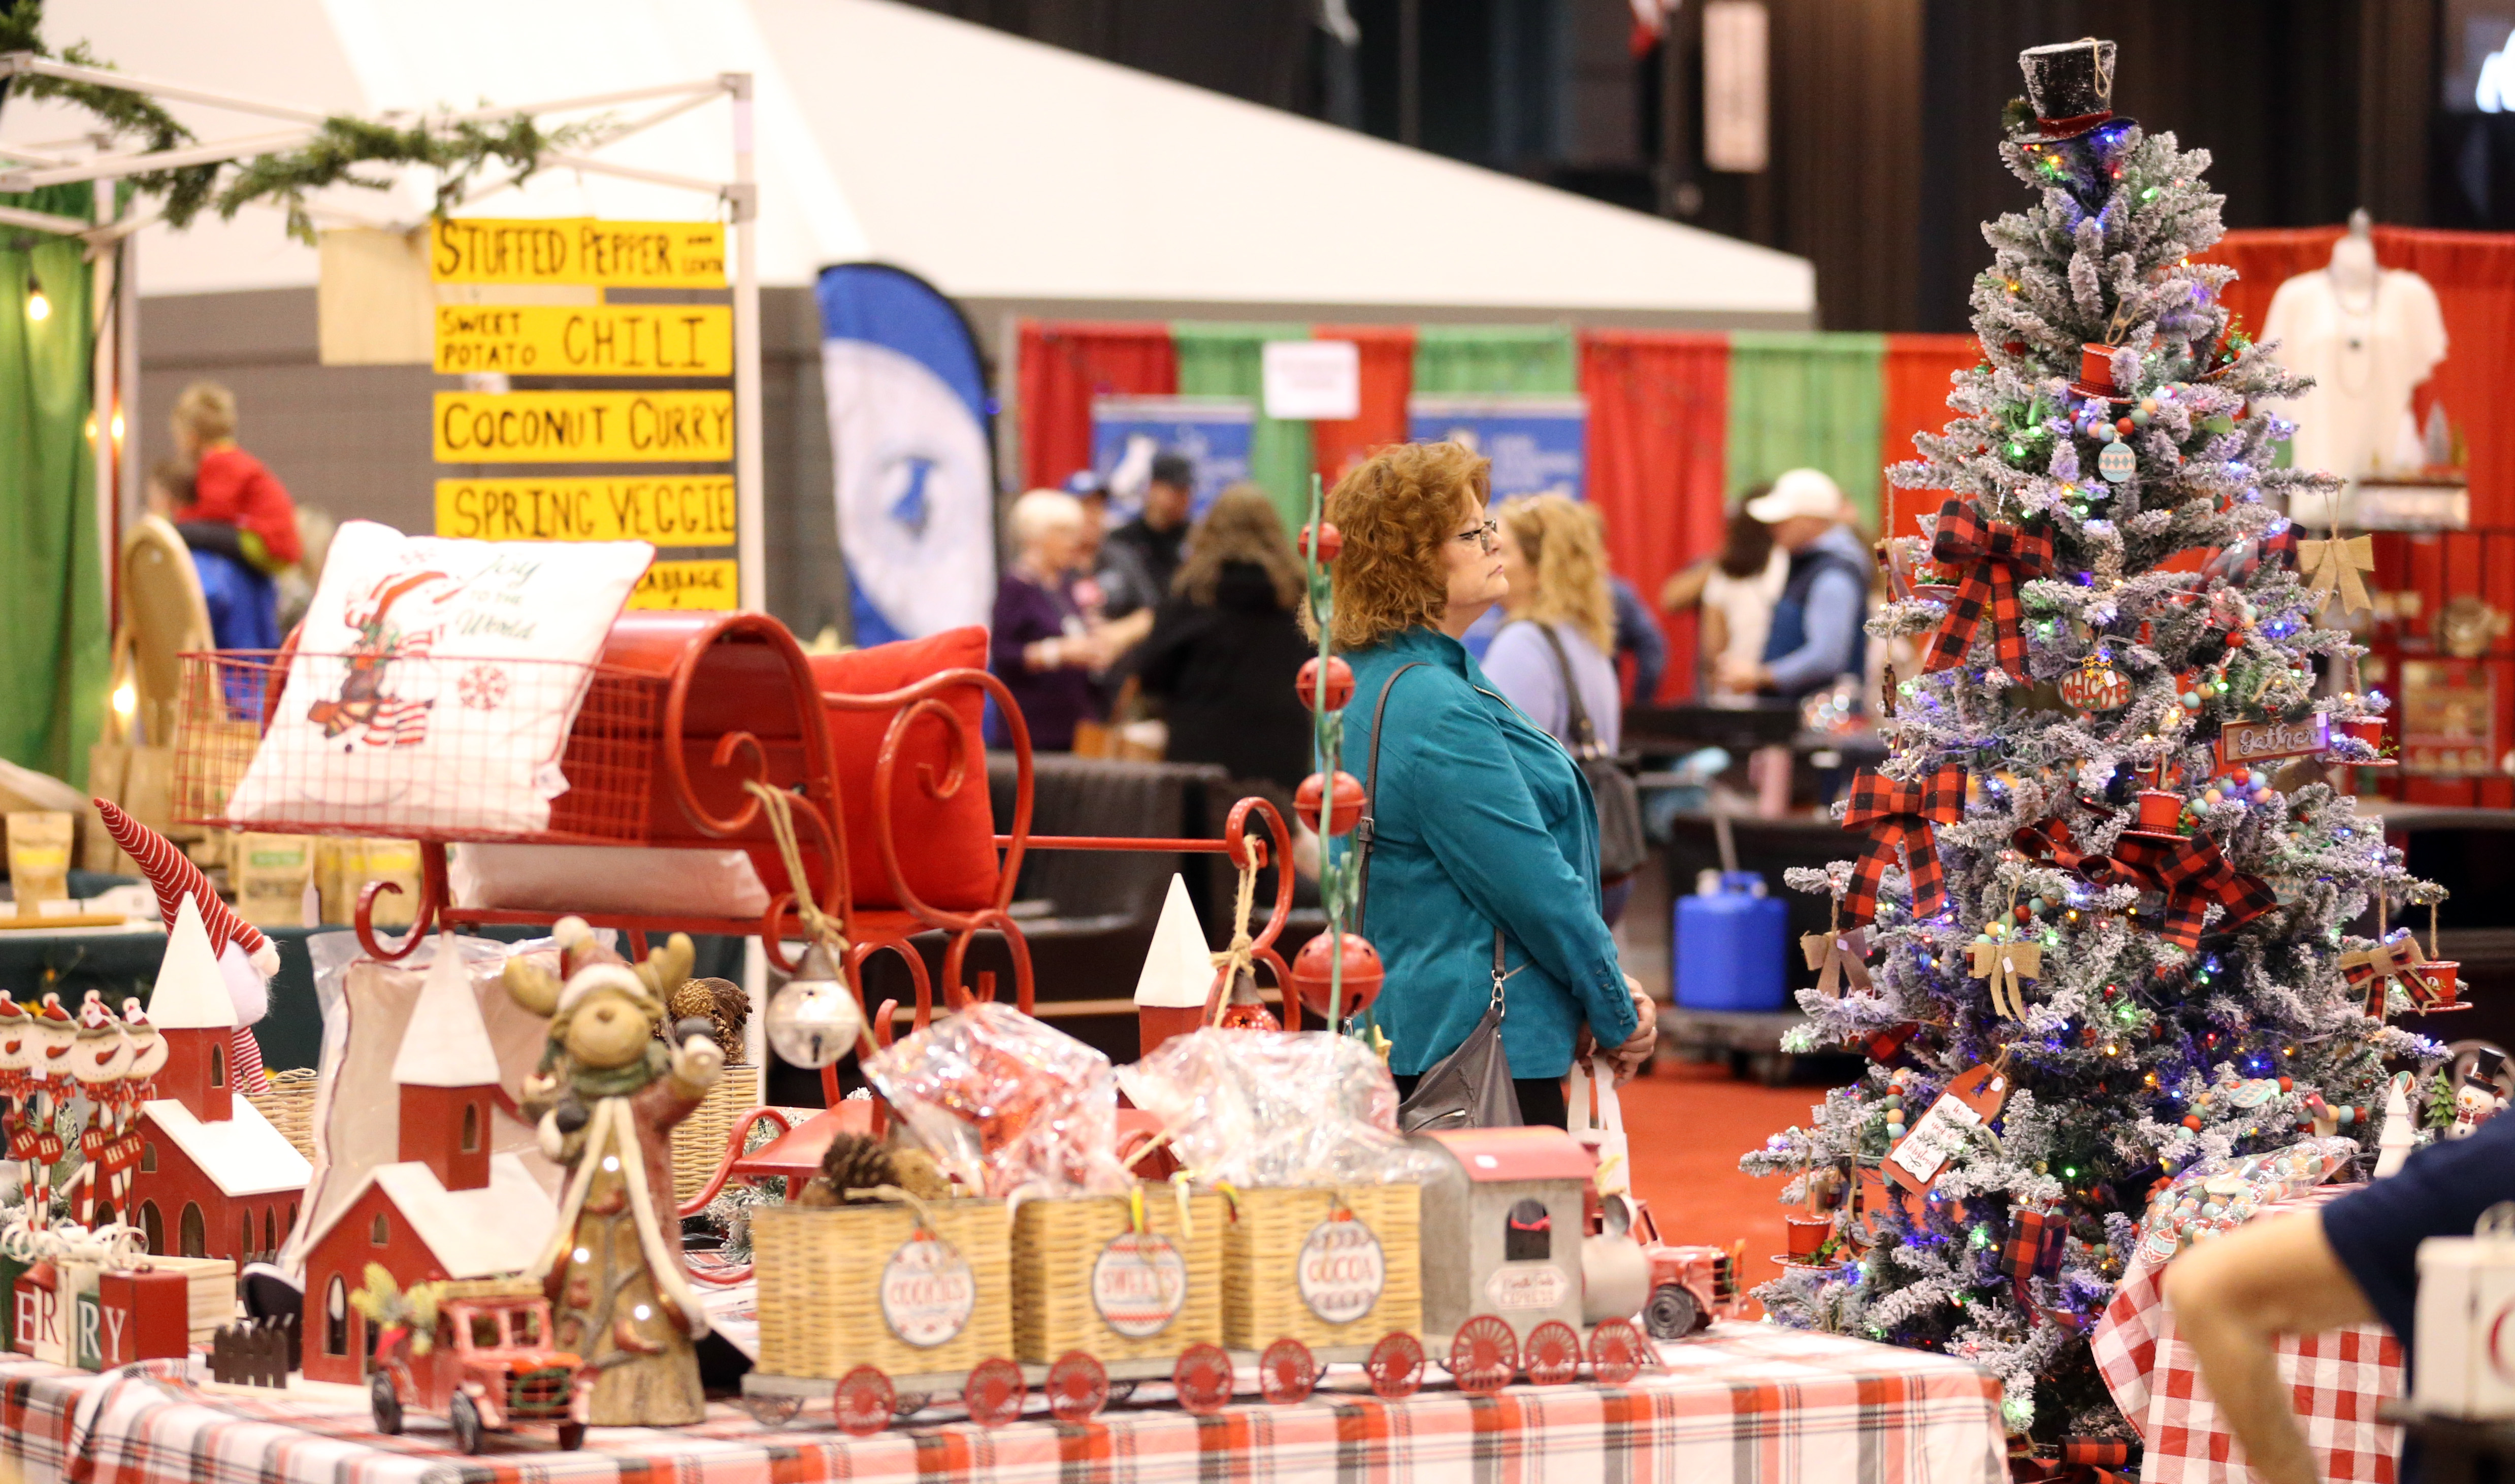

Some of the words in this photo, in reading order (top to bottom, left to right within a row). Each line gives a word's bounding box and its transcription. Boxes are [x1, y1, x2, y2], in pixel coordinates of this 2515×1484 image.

[437, 219, 567, 276] STUFFED
[579, 225, 673, 275] PEPPER
[441, 311, 520, 335] SWEET
[563, 315, 706, 368] CHILI
[443, 343, 537, 368] POTATO
[443, 401, 609, 451] COCONUT
[628, 397, 731, 451] CURRY
[454, 486, 597, 538] SPRING
[608, 482, 735, 535] VEGGIE
[16, 1131, 36, 1152] Hi
[39, 1137, 59, 1155] Hi
[85, 1132, 103, 1149] Hi
[105, 1145, 125, 1165] Hi
[1903, 1139, 1938, 1172] Christmas
